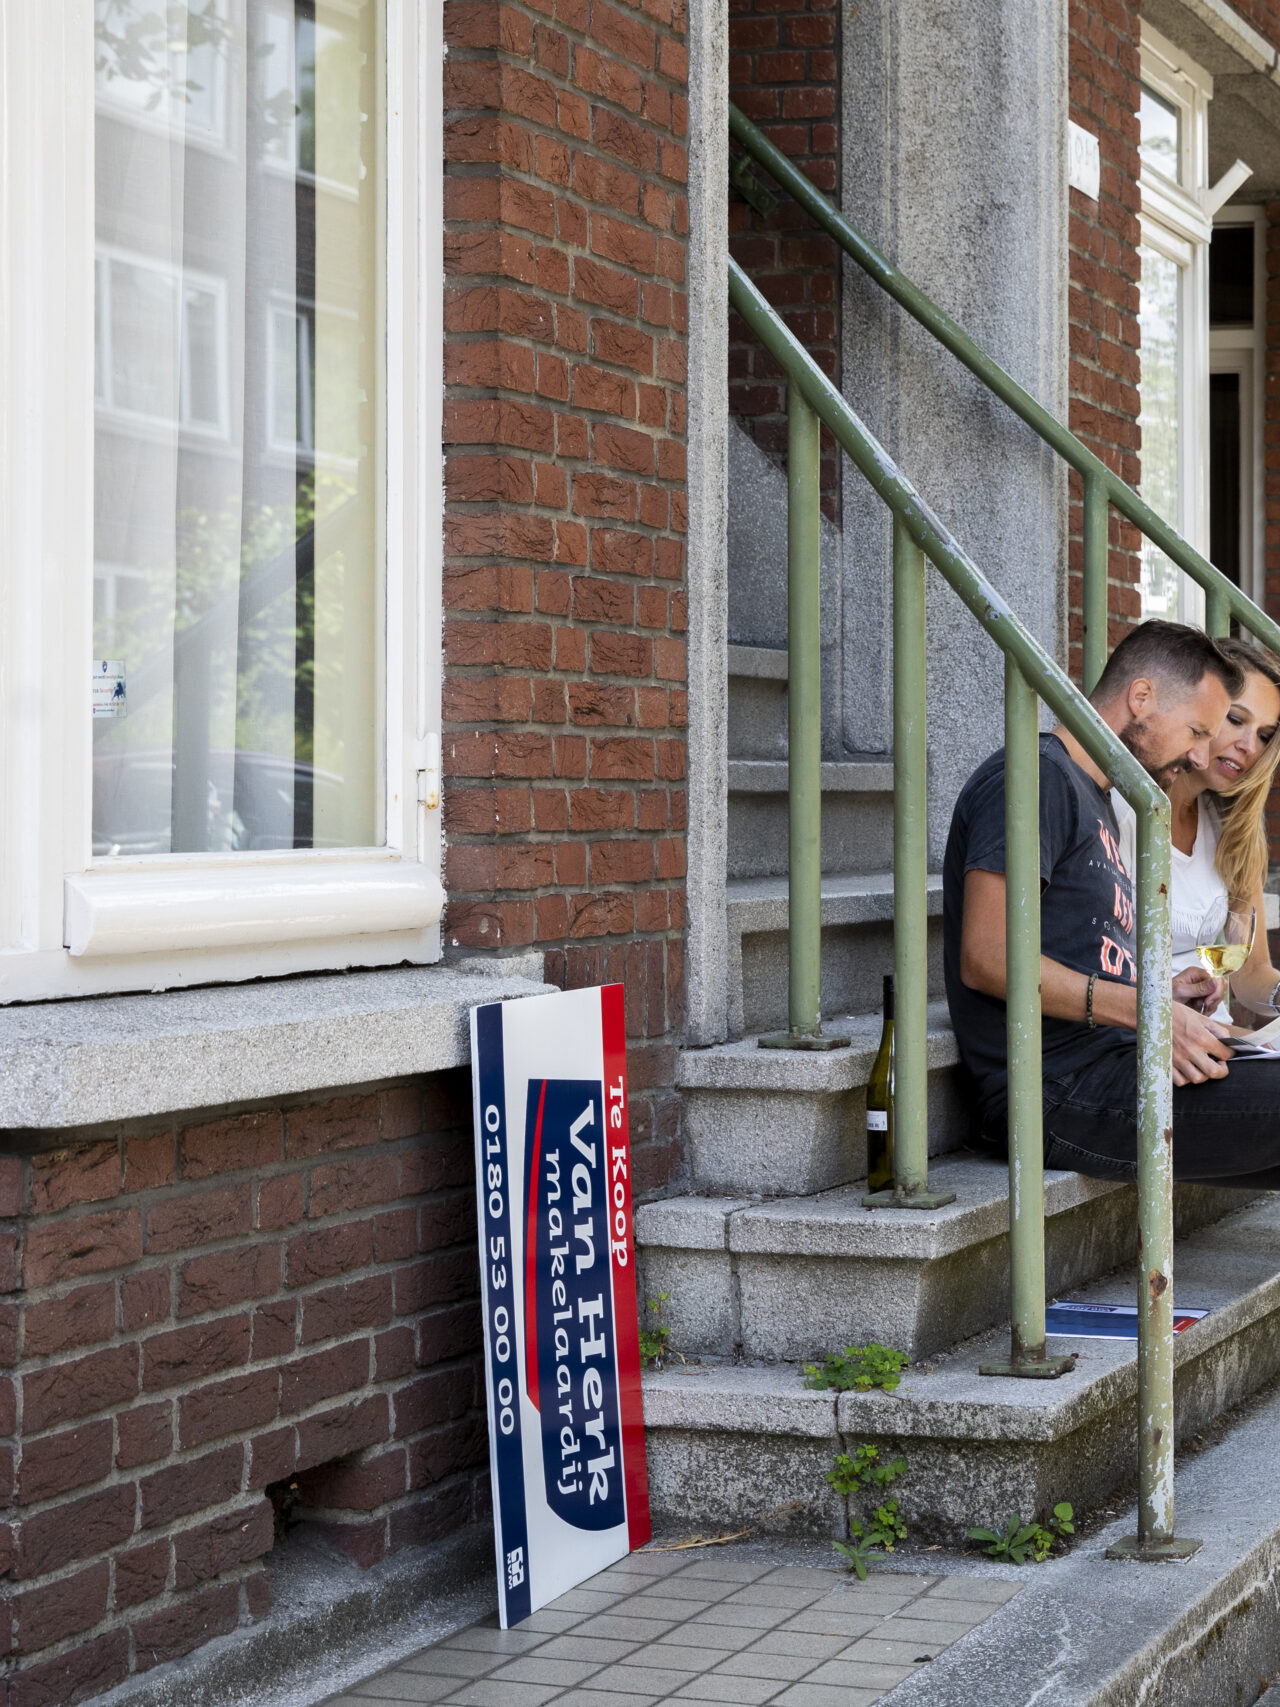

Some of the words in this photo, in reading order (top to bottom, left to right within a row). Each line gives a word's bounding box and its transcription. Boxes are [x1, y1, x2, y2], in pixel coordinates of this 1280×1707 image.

[609, 1075, 624, 1129] Te
[485, 1104, 503, 1219] 0180
[569, 1099, 597, 1275] Van
[612, 1145, 628, 1267] Koop
[490, 1236, 507, 1291] 53
[494, 1305, 511, 1363] 00
[545, 1148, 583, 1495] makelaardij
[498, 1377, 515, 1436] 00
[577, 1293, 615, 1506] Herk
